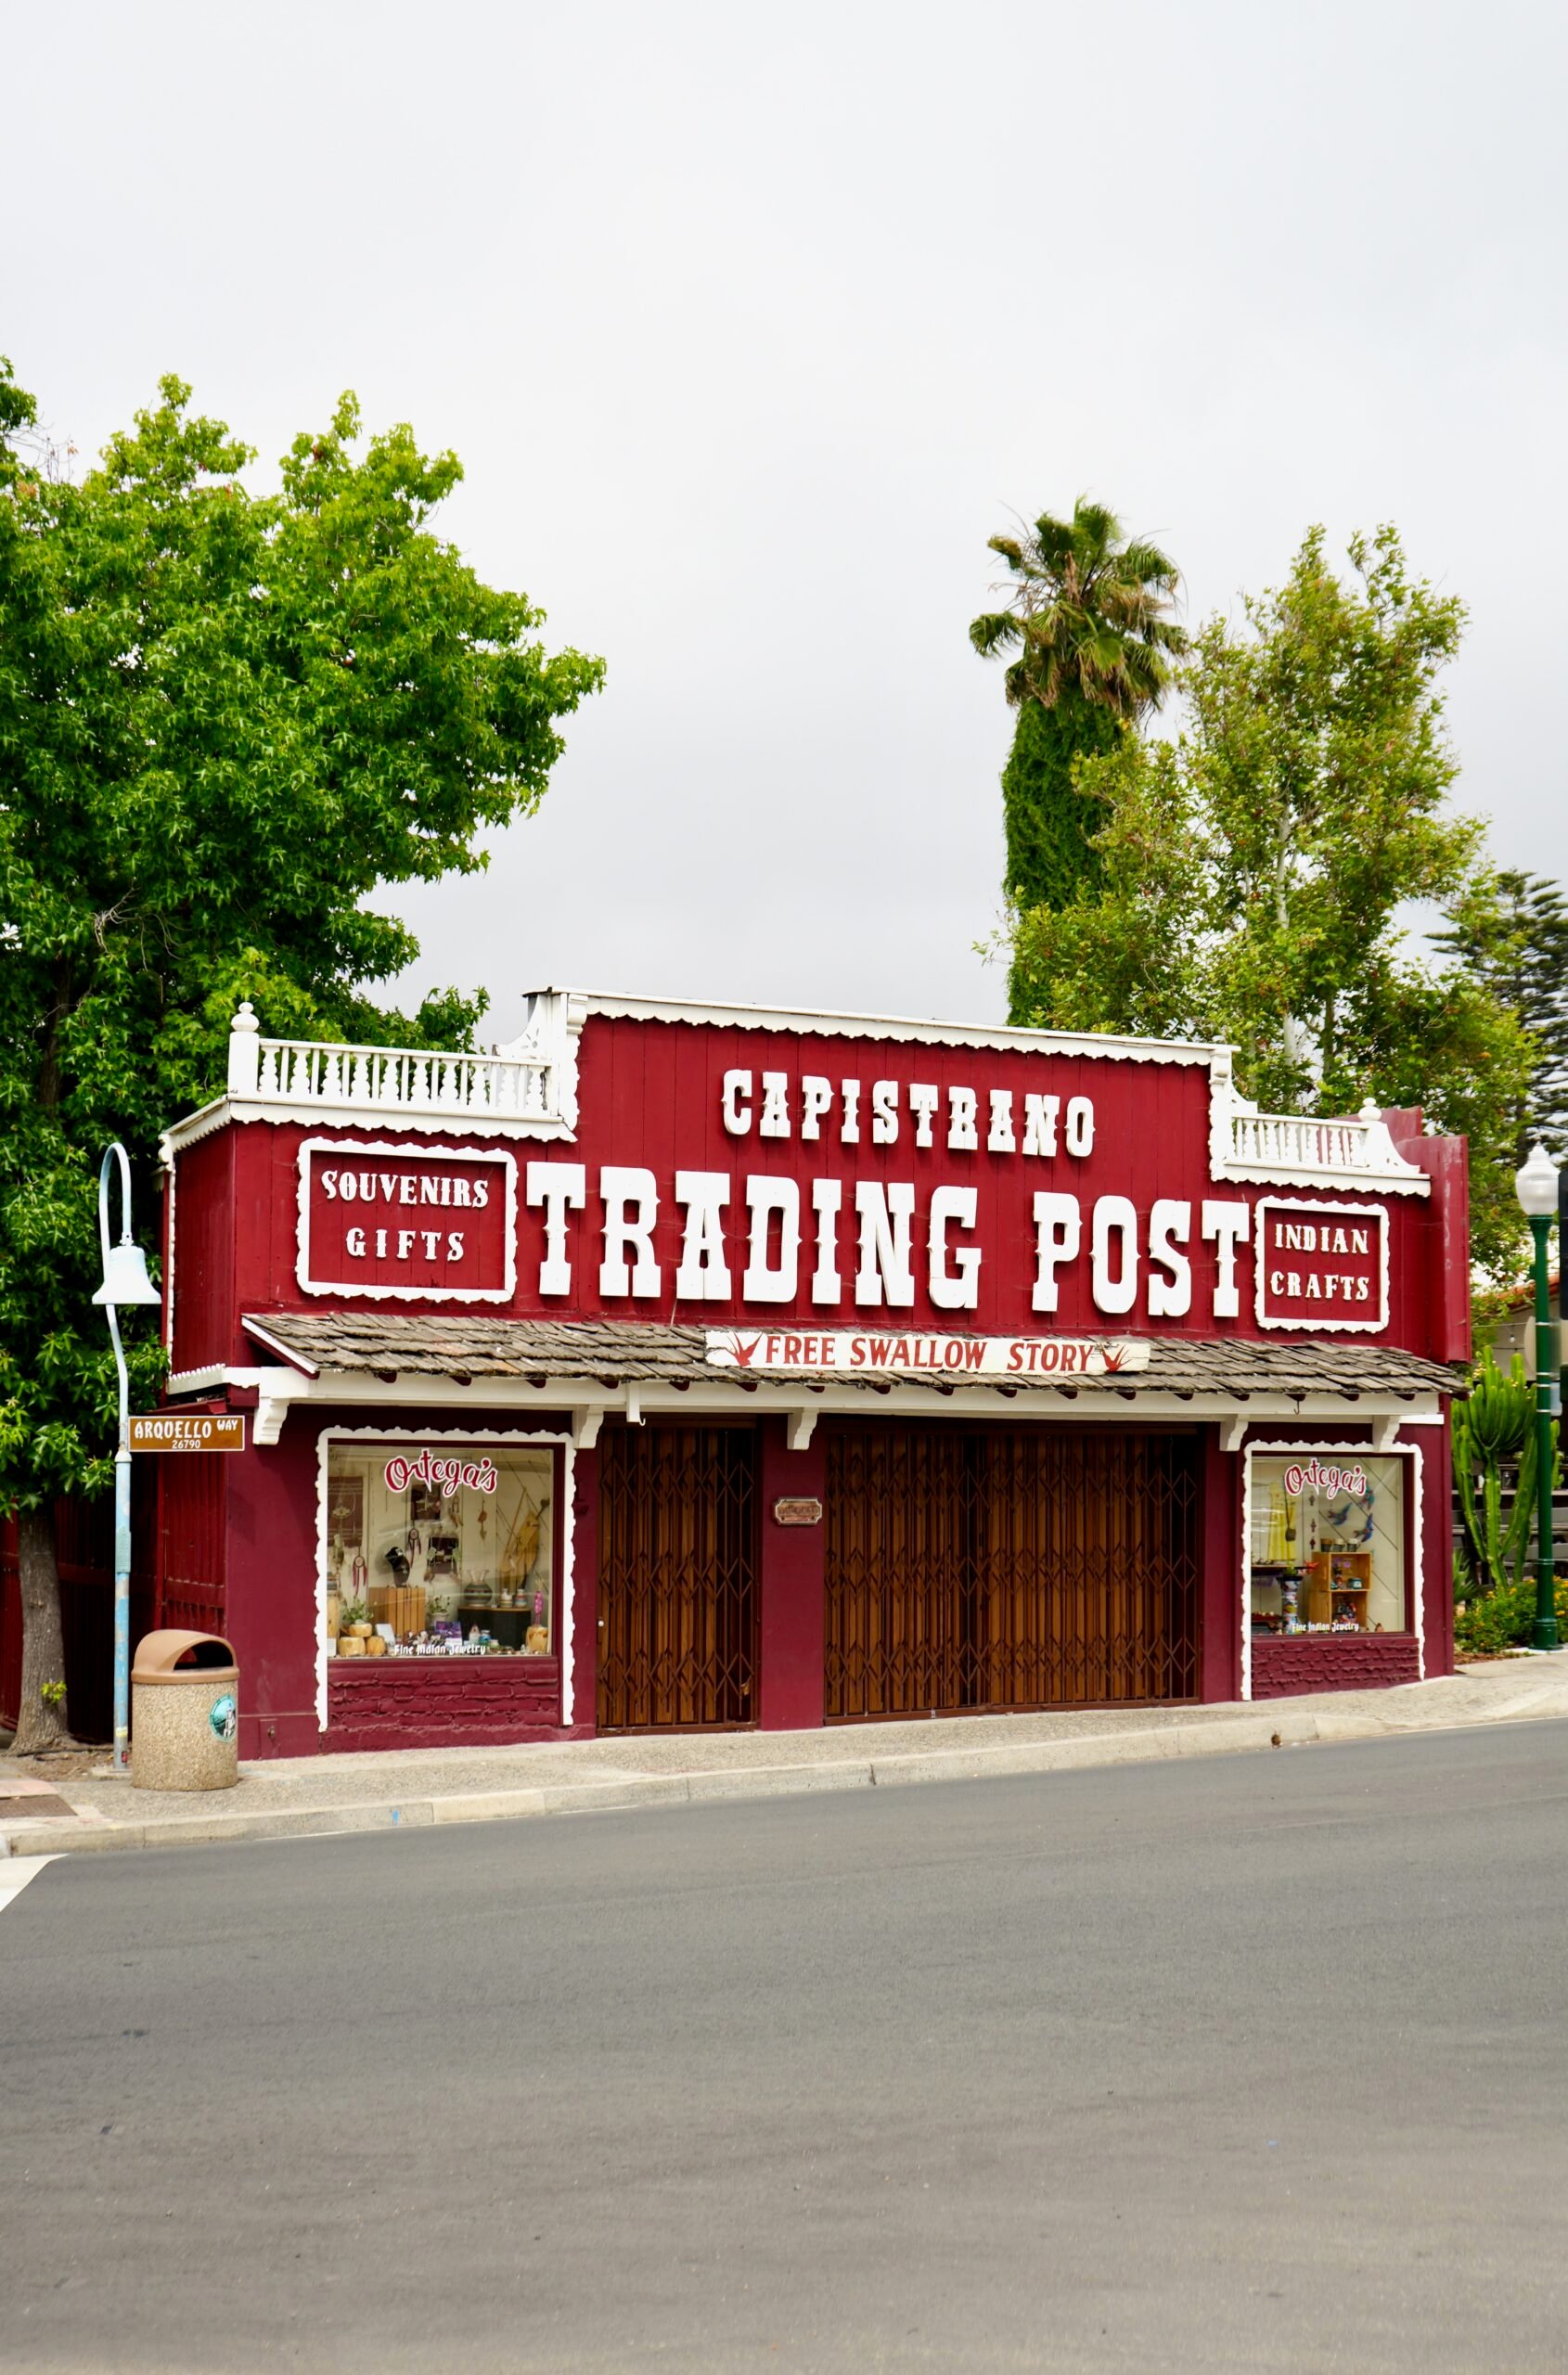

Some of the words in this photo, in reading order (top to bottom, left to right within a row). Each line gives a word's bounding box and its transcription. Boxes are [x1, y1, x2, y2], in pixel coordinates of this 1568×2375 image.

[721, 1070, 1096, 1157] CAPISTRANO
[321, 1170, 488, 1208] SOUVENIRS
[346, 1227, 464, 1261] GIFTS
[526, 1162, 982, 1309] TRADING
[1032, 1191, 1250, 1317] POST
[1275, 1223, 1369, 1254] INDIAN
[1270, 1271, 1369, 1301] CRAFTS
[765, 1335, 834, 1365] FREE
[850, 1338, 986, 1369] SWALLOW
[1007, 1342, 1093, 1372] STORY
[135, 1420, 212, 1439] ARQUELLO
[216, 1419, 238, 1431] WAY
[172, 1439, 200, 1449] 26790
[384, 1448, 498, 1497] Ortega's
[1285, 1457, 1367, 1499] Ortega's
[394, 1644, 414, 1655] Fine
[448, 1644, 486, 1656] Jewelry
